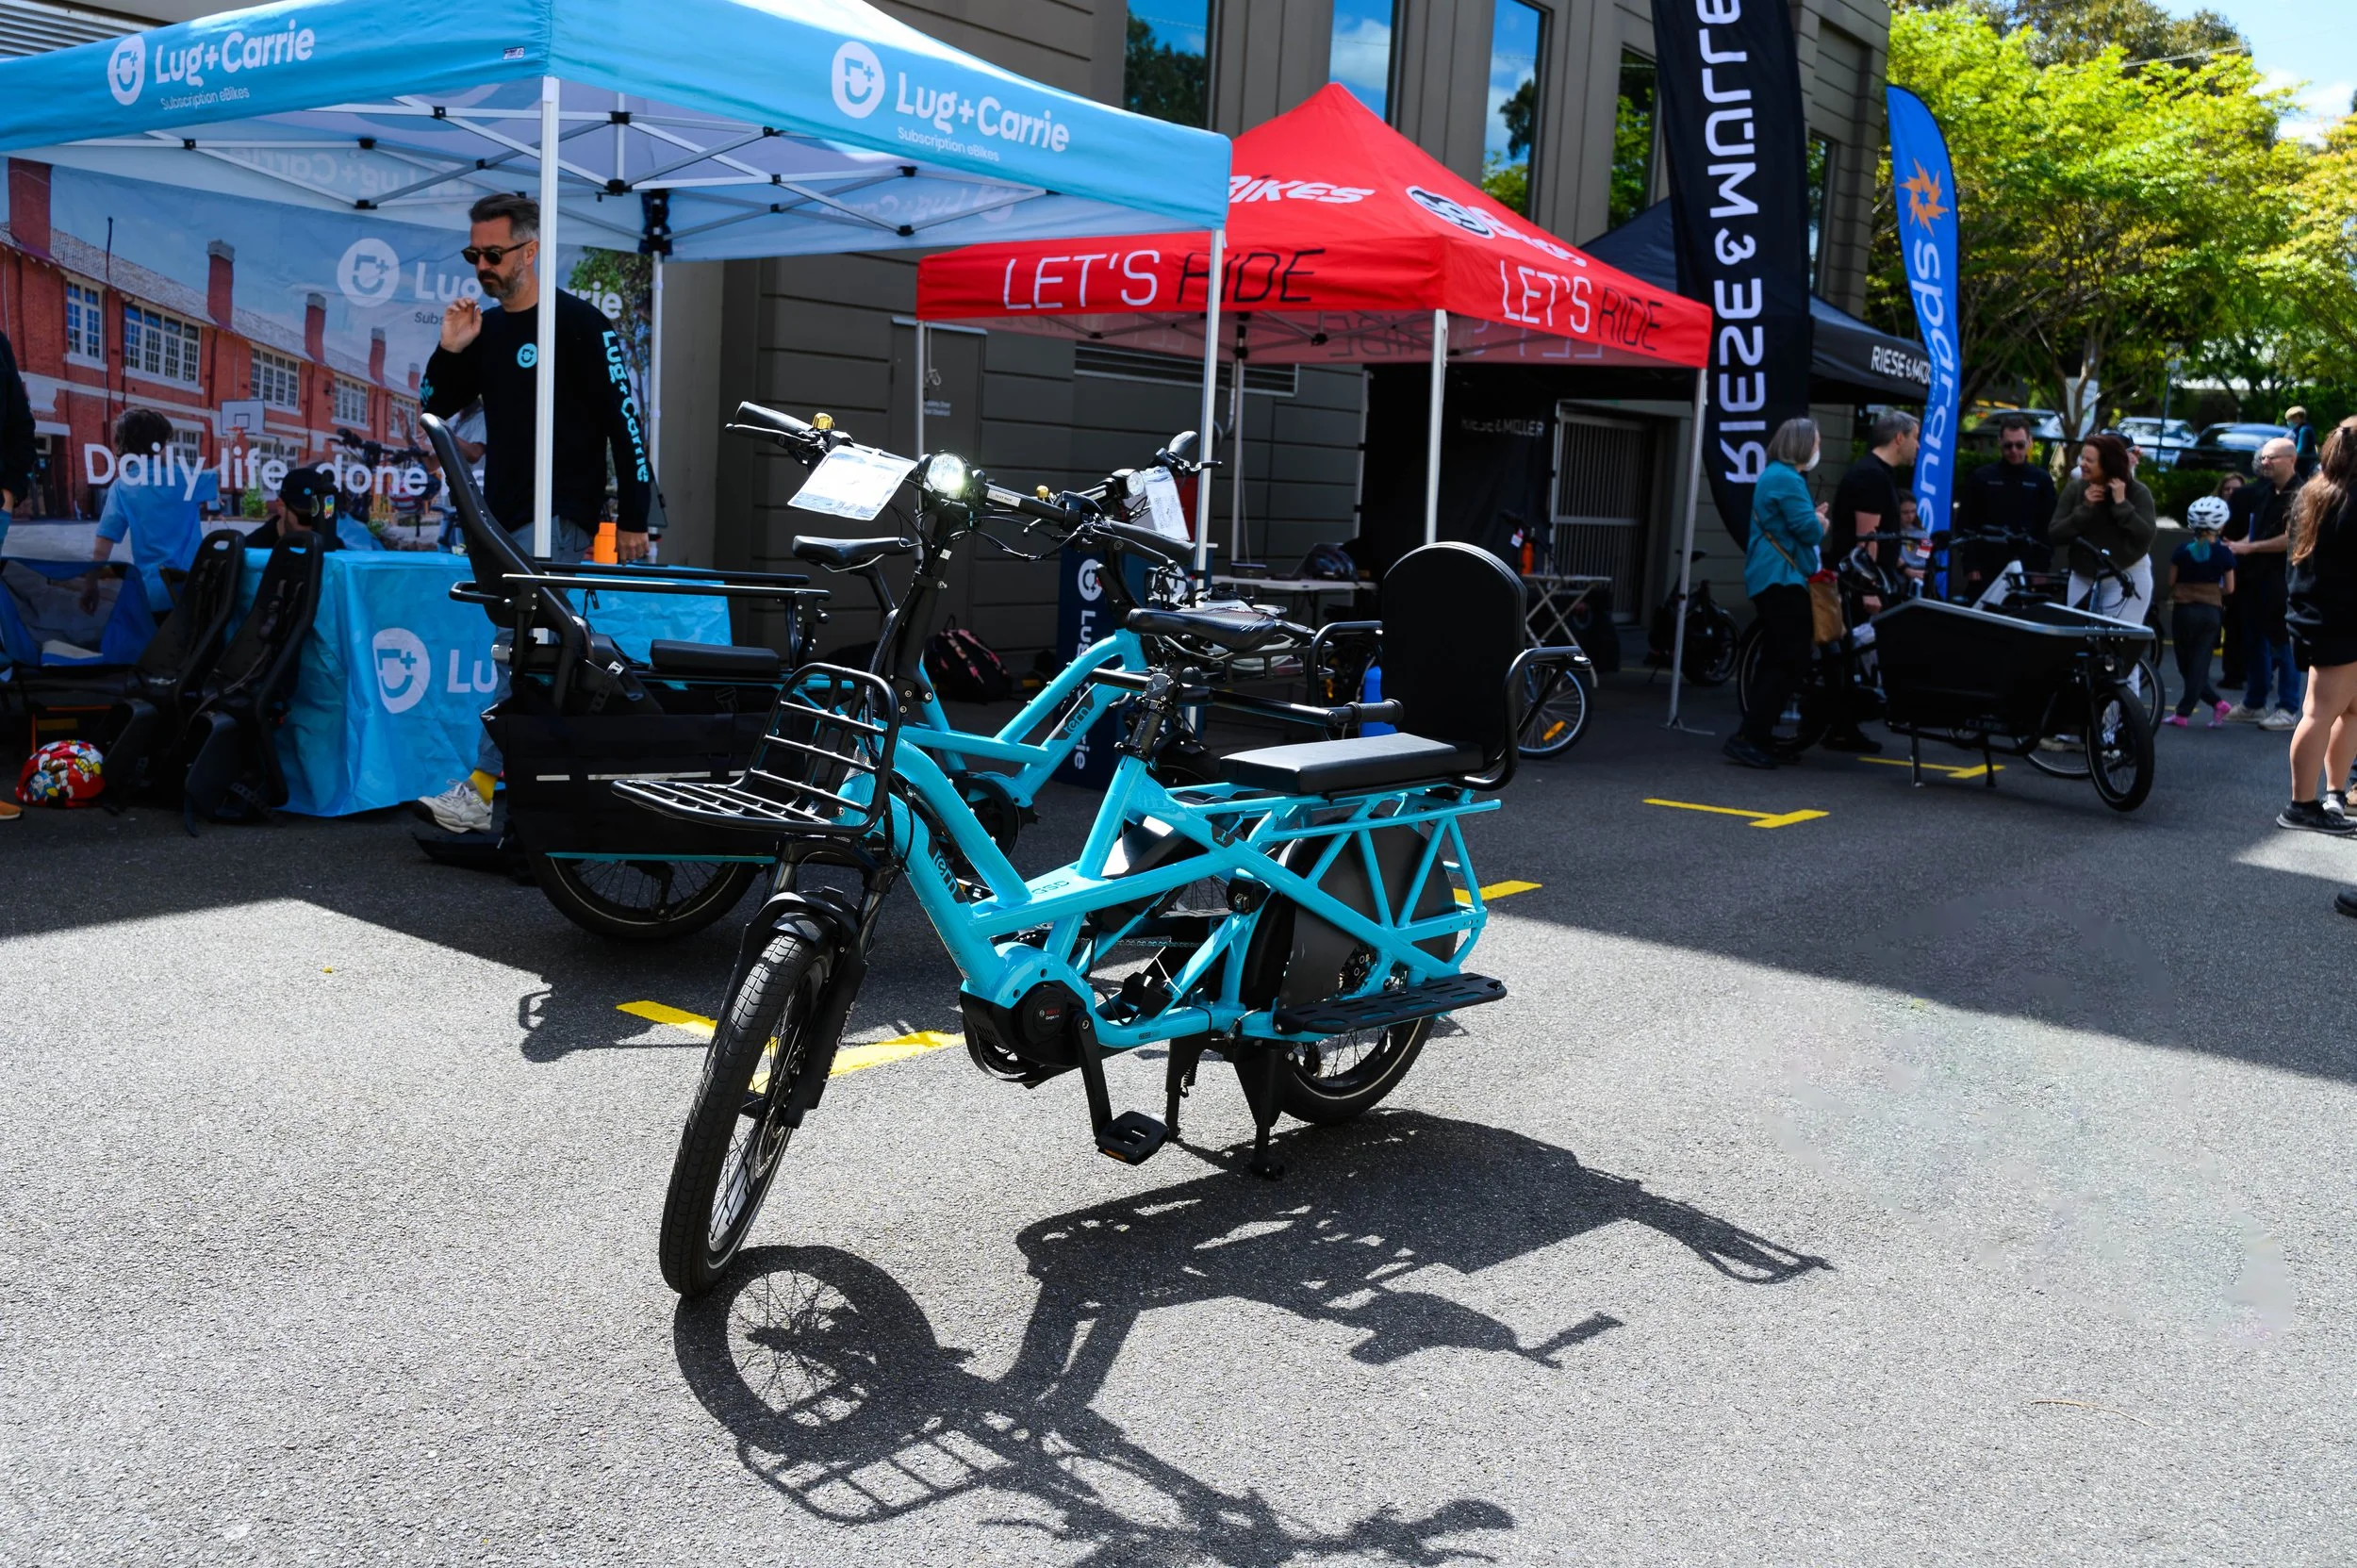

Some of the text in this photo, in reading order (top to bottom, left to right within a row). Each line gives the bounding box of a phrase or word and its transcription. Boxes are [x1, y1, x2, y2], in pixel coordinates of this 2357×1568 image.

[155, 19, 316, 88] Lug+Carrie
[160, 86, 250, 110] Subscription eBikes
[896, 72, 1070, 152] Lug+Carrie
[898, 126, 1000, 162] Subscription eBikes
[1002, 249, 1161, 310] LET'S
[1500, 259, 1592, 334] LET'S
[1598, 287, 1663, 352] RIDE
[1871, 345, 1906, 378] RIESE
[602, 330, 650, 483] Lug+Carrie
[84, 441, 206, 502] Daily
[316, 454, 428, 497] done
[1063, 705, 1091, 734] tern
[932, 850, 959, 896] tern
